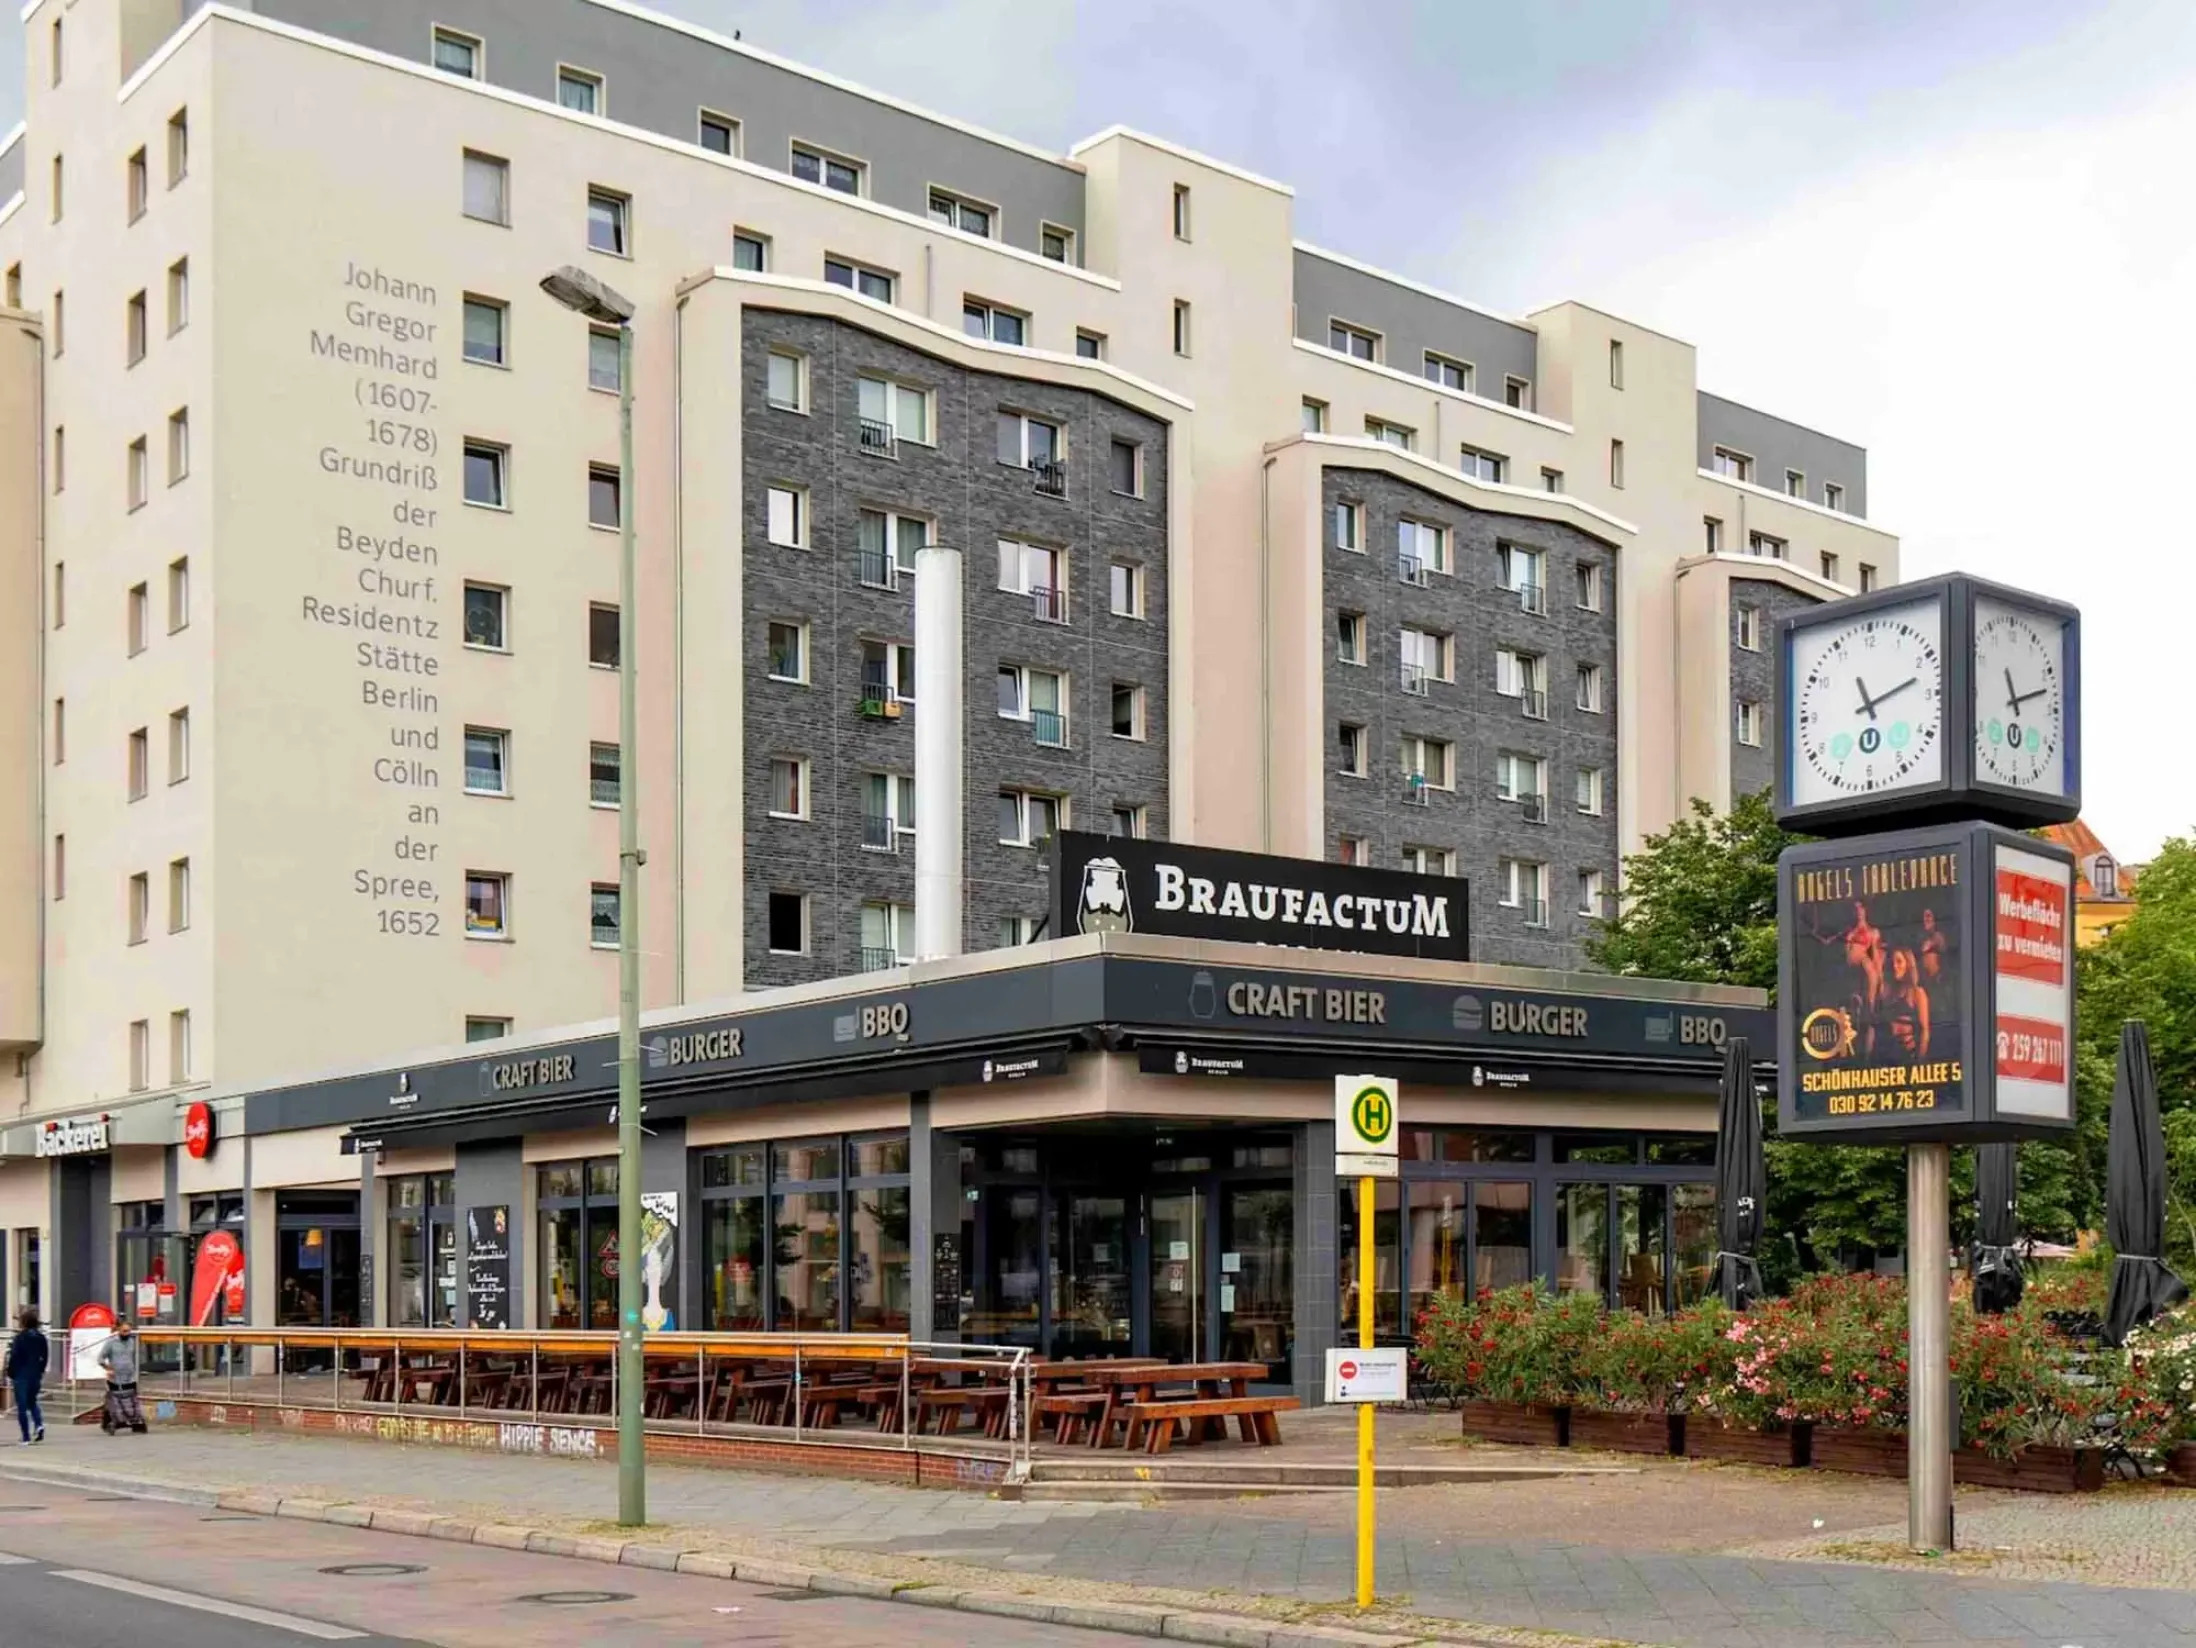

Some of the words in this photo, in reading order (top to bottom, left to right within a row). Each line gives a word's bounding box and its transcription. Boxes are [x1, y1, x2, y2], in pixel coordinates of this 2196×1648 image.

[344, 262, 436, 307] Johann
[345, 301, 437, 343] Gregor
[310, 329, 438, 380] Memhard
[355, 377, 438, 414] (1607-
[366, 418, 438, 458] 1678)
[319, 446, 438, 491] Grundriß
[393, 499, 438, 529] der
[336, 525, 438, 567] Beyden
[357, 567, 438, 604] Churf.
[302, 596, 439, 640] Residentz
[356, 641, 439, 677] Stätte
[362, 680, 438, 713] Berlin
[391, 726, 438, 751] und
[374, 757, 438, 788] Cölln
[408, 805, 438, 826] an
[395, 835, 438, 862] der
[354, 869, 439, 904] Spree,
[1154, 863, 1451, 939] BRAUFACTUM
[1797, 867, 1852, 904] ANGELS
[378, 909, 440, 937] 1652
[862, 1002, 909, 1041] BBQ
[1227, 981, 1318, 1020] CRAFT
[1324, 988, 1387, 1025] BIER
[1490, 1001, 1589, 1037] BURGER
[670, 1027, 742, 1066] BURGER
[1680, 1015, 1728, 1053] BBQ
[492, 1060, 537, 1090] CRAFT
[539, 1054, 573, 1084] BIER
[1802, 1066, 1907, 1093] SCHÖNHAUSER
[1909, 1062, 1948, 1085] ALLEE
[1951, 1061, 1962, 1082] 5
[1365, 1099, 1384, 1131] H
[1829, 1095, 1856, 1115] 030
[1858, 1093, 1877, 1113] 92
[1879, 1092, 1893, 1111] 14
[1896, 1091, 1913, 1110] 76
[1916, 1089, 1934, 1108] 23
